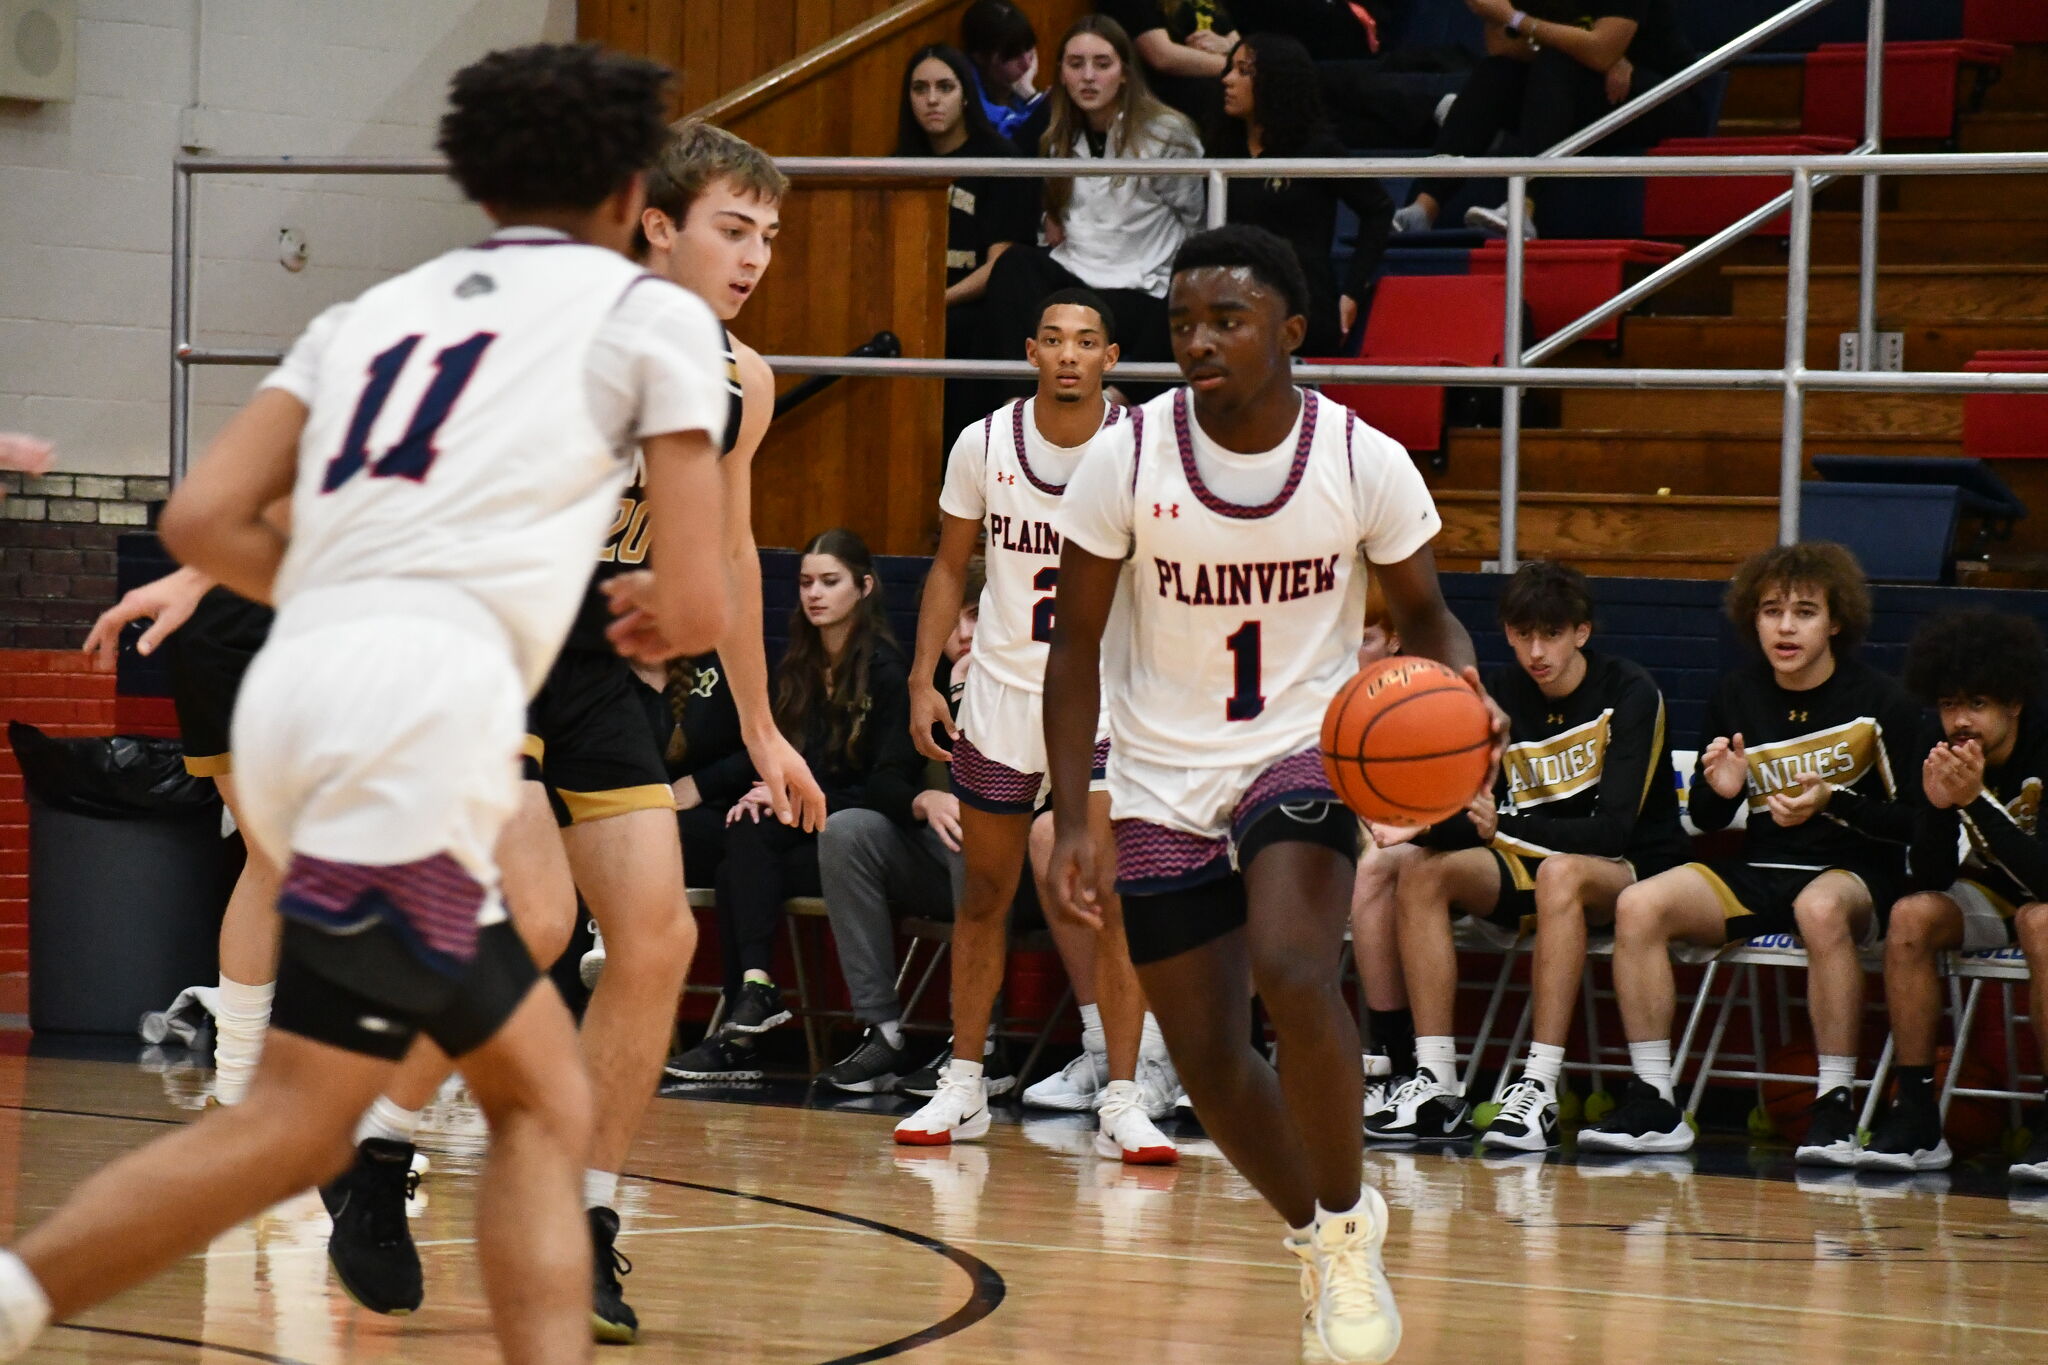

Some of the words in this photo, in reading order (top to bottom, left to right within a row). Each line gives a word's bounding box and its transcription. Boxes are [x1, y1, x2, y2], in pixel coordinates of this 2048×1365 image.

[314, 330, 502, 496] 11
[990, 512, 1061, 555] PLAIN
[1154, 553, 1340, 606] PLAINVIEW
[1226, 619, 1267, 722] 1
